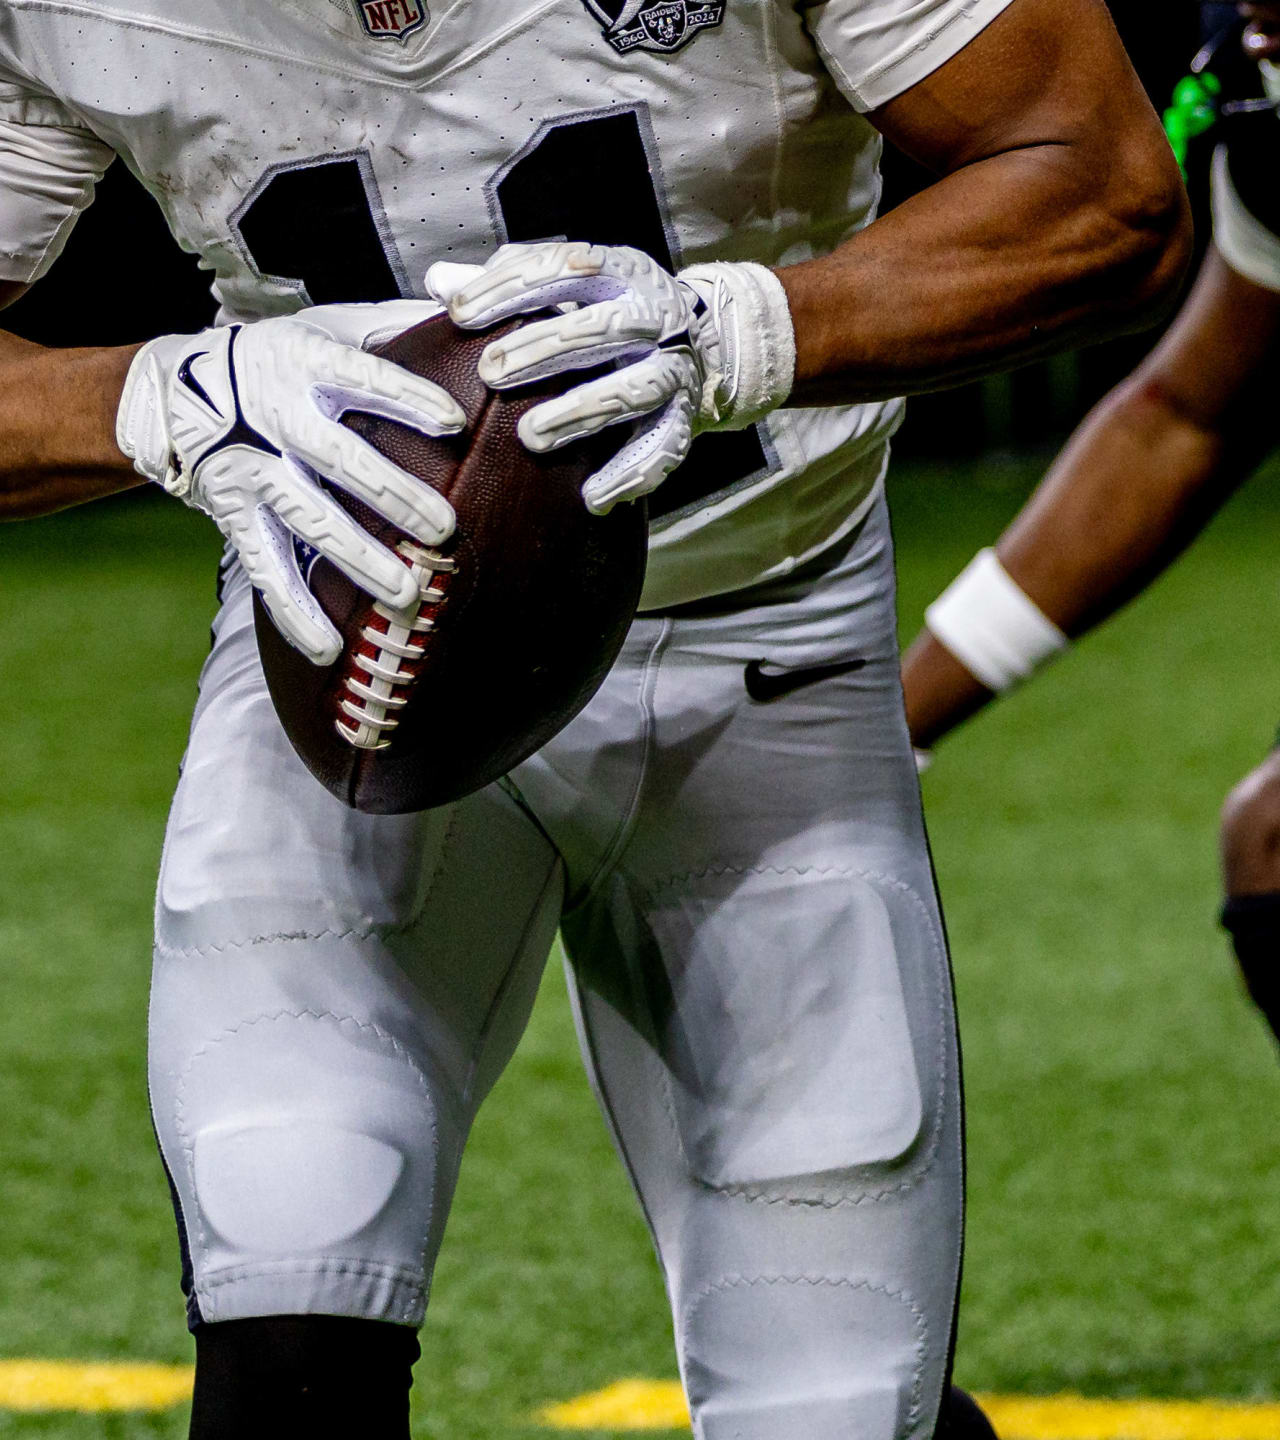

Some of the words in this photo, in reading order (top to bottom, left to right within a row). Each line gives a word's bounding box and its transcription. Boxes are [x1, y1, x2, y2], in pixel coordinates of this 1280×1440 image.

[645, 4, 682, 21] RAIDERS
[688, 13, 715, 24] 2024
[619, 32, 645, 47] 1960
